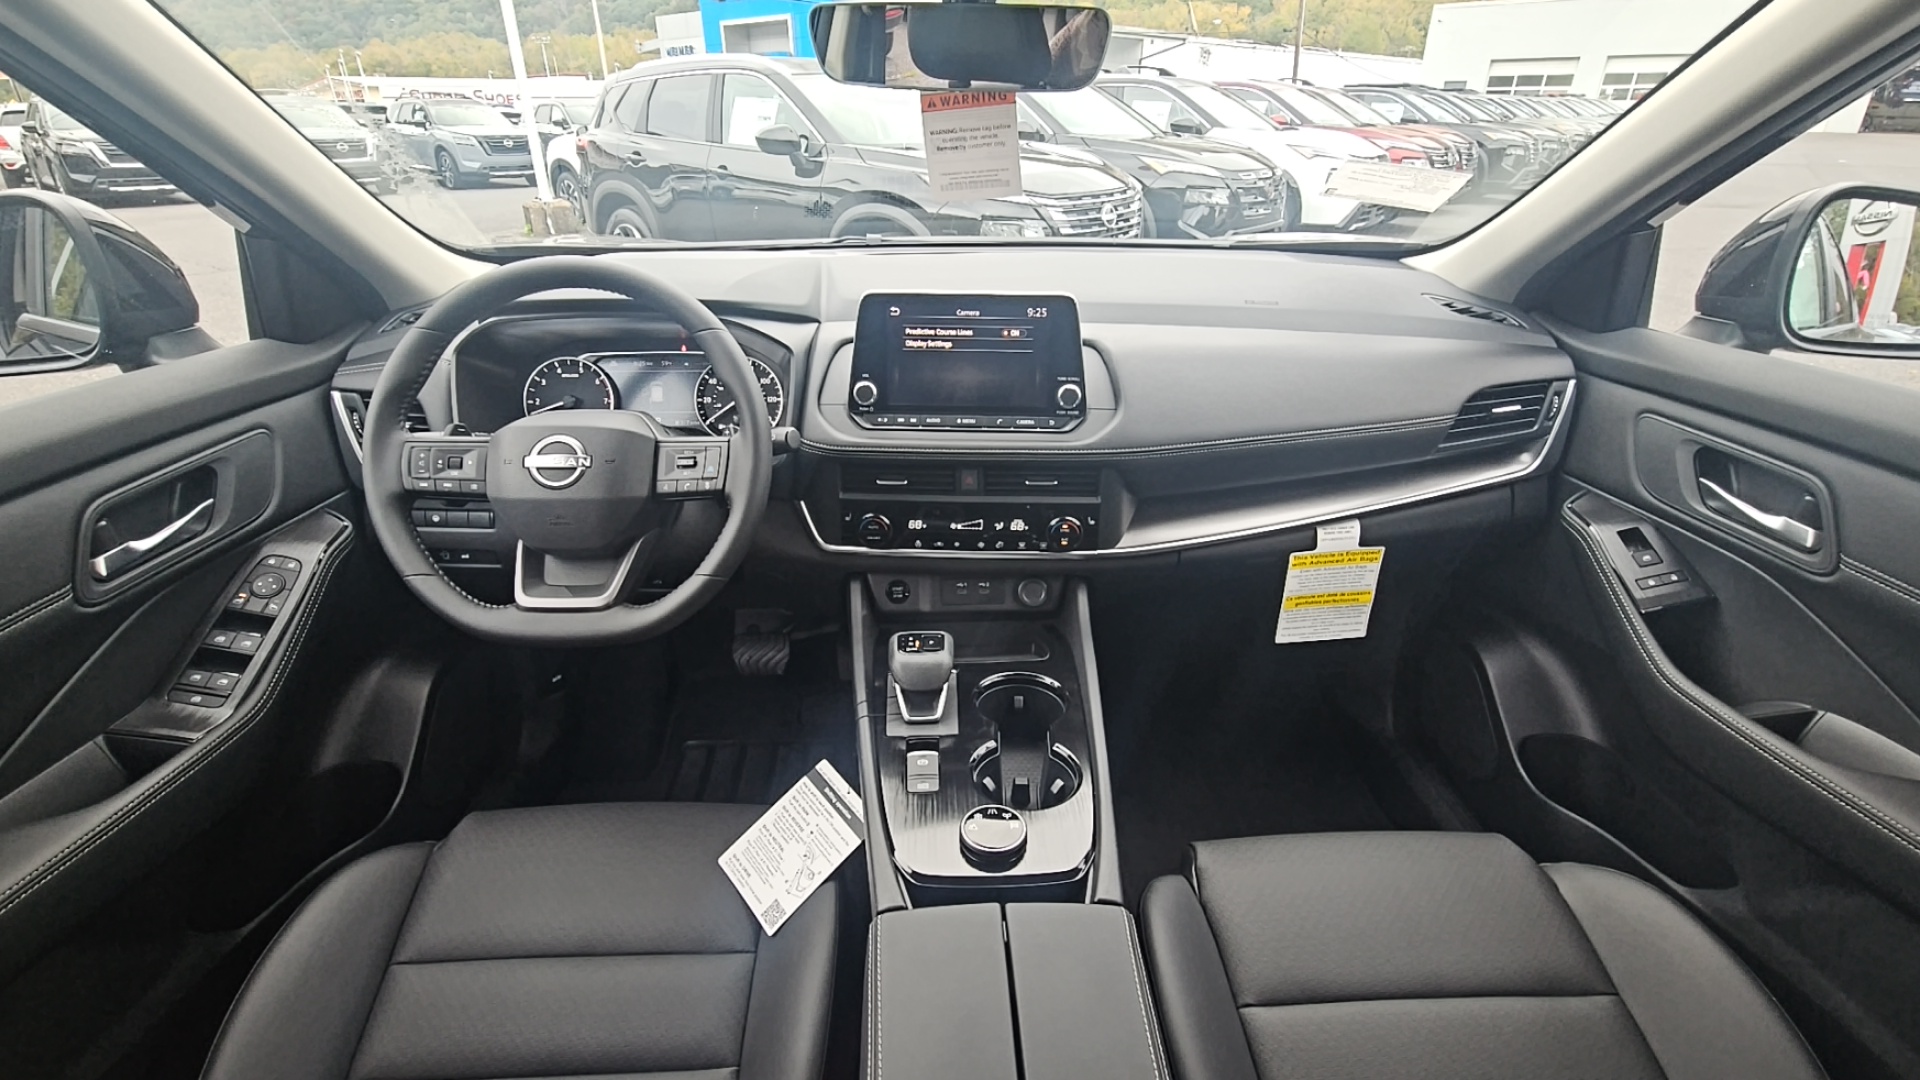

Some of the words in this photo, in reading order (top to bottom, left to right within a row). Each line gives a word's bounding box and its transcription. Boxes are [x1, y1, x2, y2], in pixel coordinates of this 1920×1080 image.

[940, 91, 1007, 107] WARNING
[1026, 308, 1048, 318] 9:25
[905, 328, 935, 336] Predictive
[905, 340, 928, 348] Display
[928, 340, 952, 348] Settings
[1346, 550, 1381, 558] Equipped
[1309, 558, 1345, 566] Advanced
